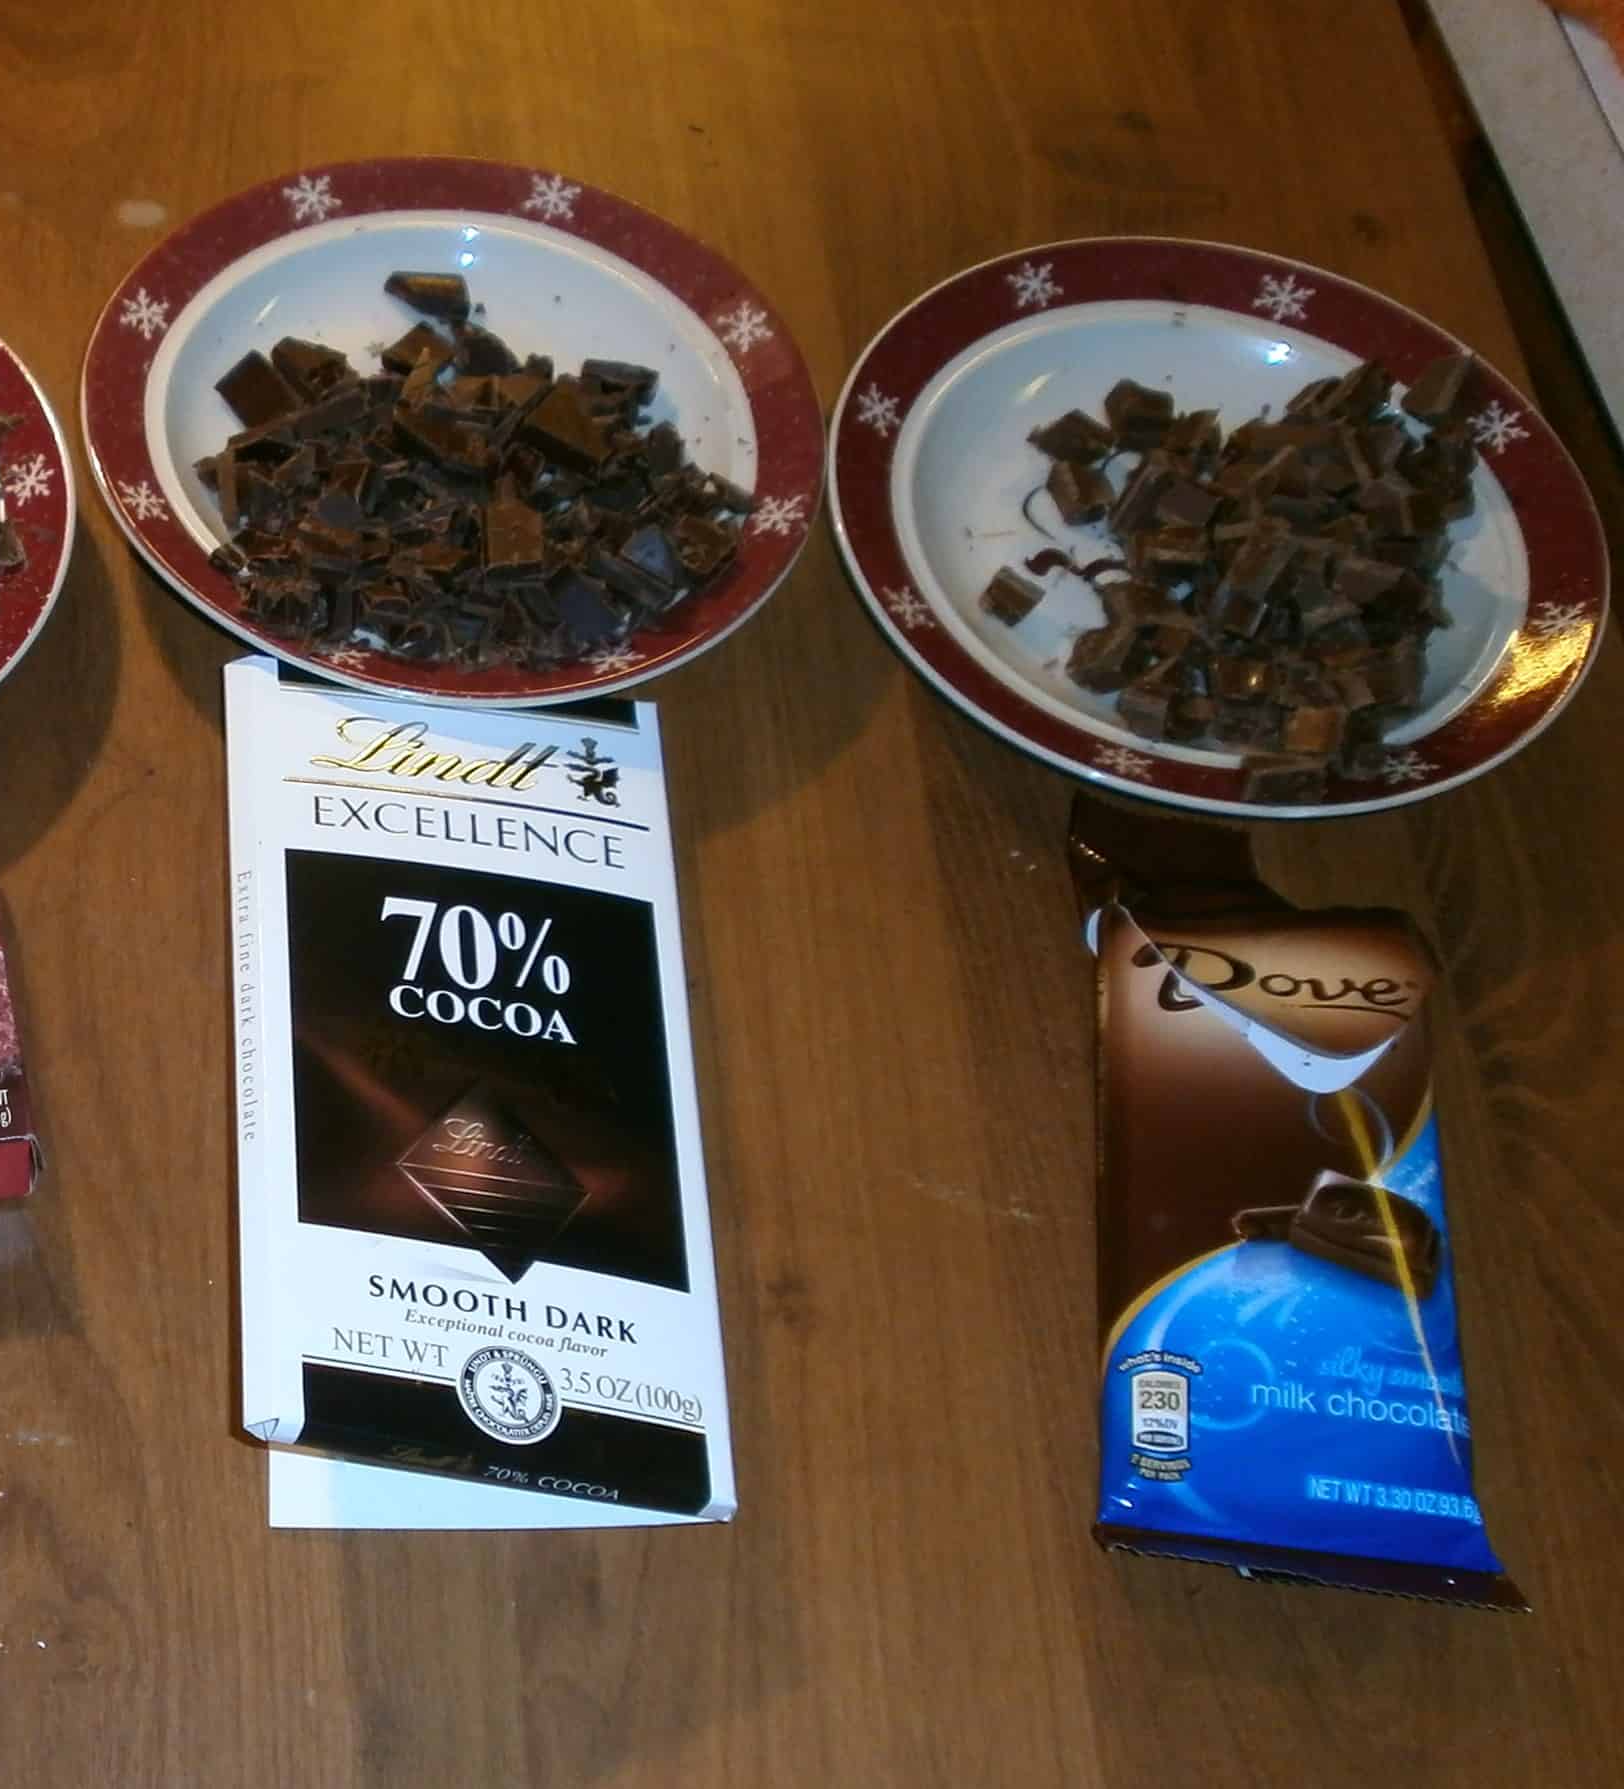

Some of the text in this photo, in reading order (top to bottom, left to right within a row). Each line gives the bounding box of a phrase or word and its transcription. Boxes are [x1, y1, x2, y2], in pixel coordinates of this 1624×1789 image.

[310, 716, 560, 792] Lindt
[313, 796, 625, 870] EXCELLENCE
[381, 896, 570, 995] 70%
[1131, 941, 1409, 1012] Dove
[237, 870, 258, 1142] Extra fine dark chocolate
[389, 985, 577, 1045] COCOA
[368, 1274, 638, 1345] SMOOTH DARK
[404, 1308, 609, 1358] Exceptional cocoa flavor
[331, 1327, 393, 1358] NET
[559, 1367, 591, 1395] 3.5
[595, 1375, 633, 1404] OZ
[634, 1380, 704, 1422] (100g)
[1140, 1390, 1181, 1411] 230
[1251, 1383, 1318, 1414] milk
[1319, 1346, 1384, 1397] silky
[484, 1465, 619, 1501] 70% COCOA
[1309, 1476, 1341, 1501] NET
[1345, 1482, 1372, 1505] WT
[1376, 1485, 1411, 1511] 3.30
[1415, 1490, 1437, 1514] OZ
